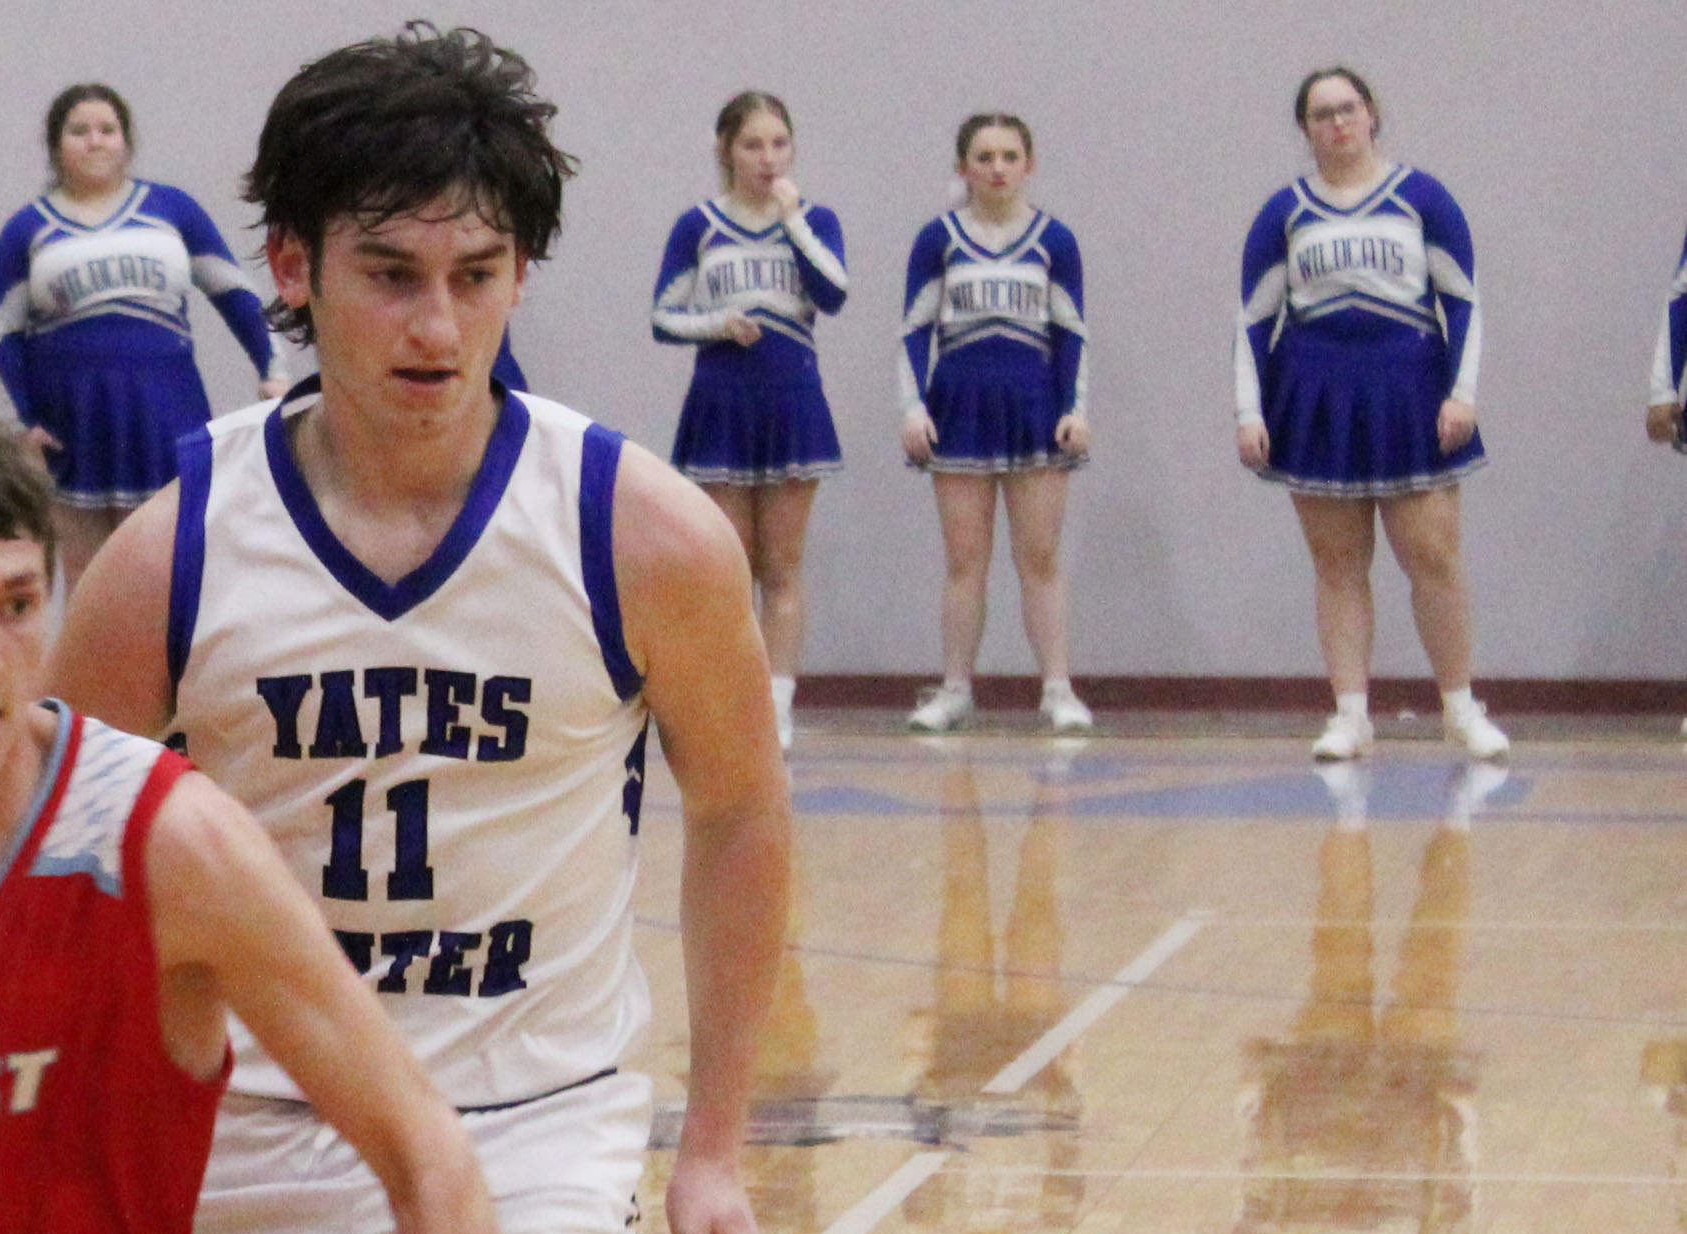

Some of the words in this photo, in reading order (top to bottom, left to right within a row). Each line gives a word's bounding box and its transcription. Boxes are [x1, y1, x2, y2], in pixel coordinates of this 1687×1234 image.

[1297, 237, 1404, 283] WILDCATS
[256, 666, 532, 762] YATES
[322, 778, 434, 901] 11
